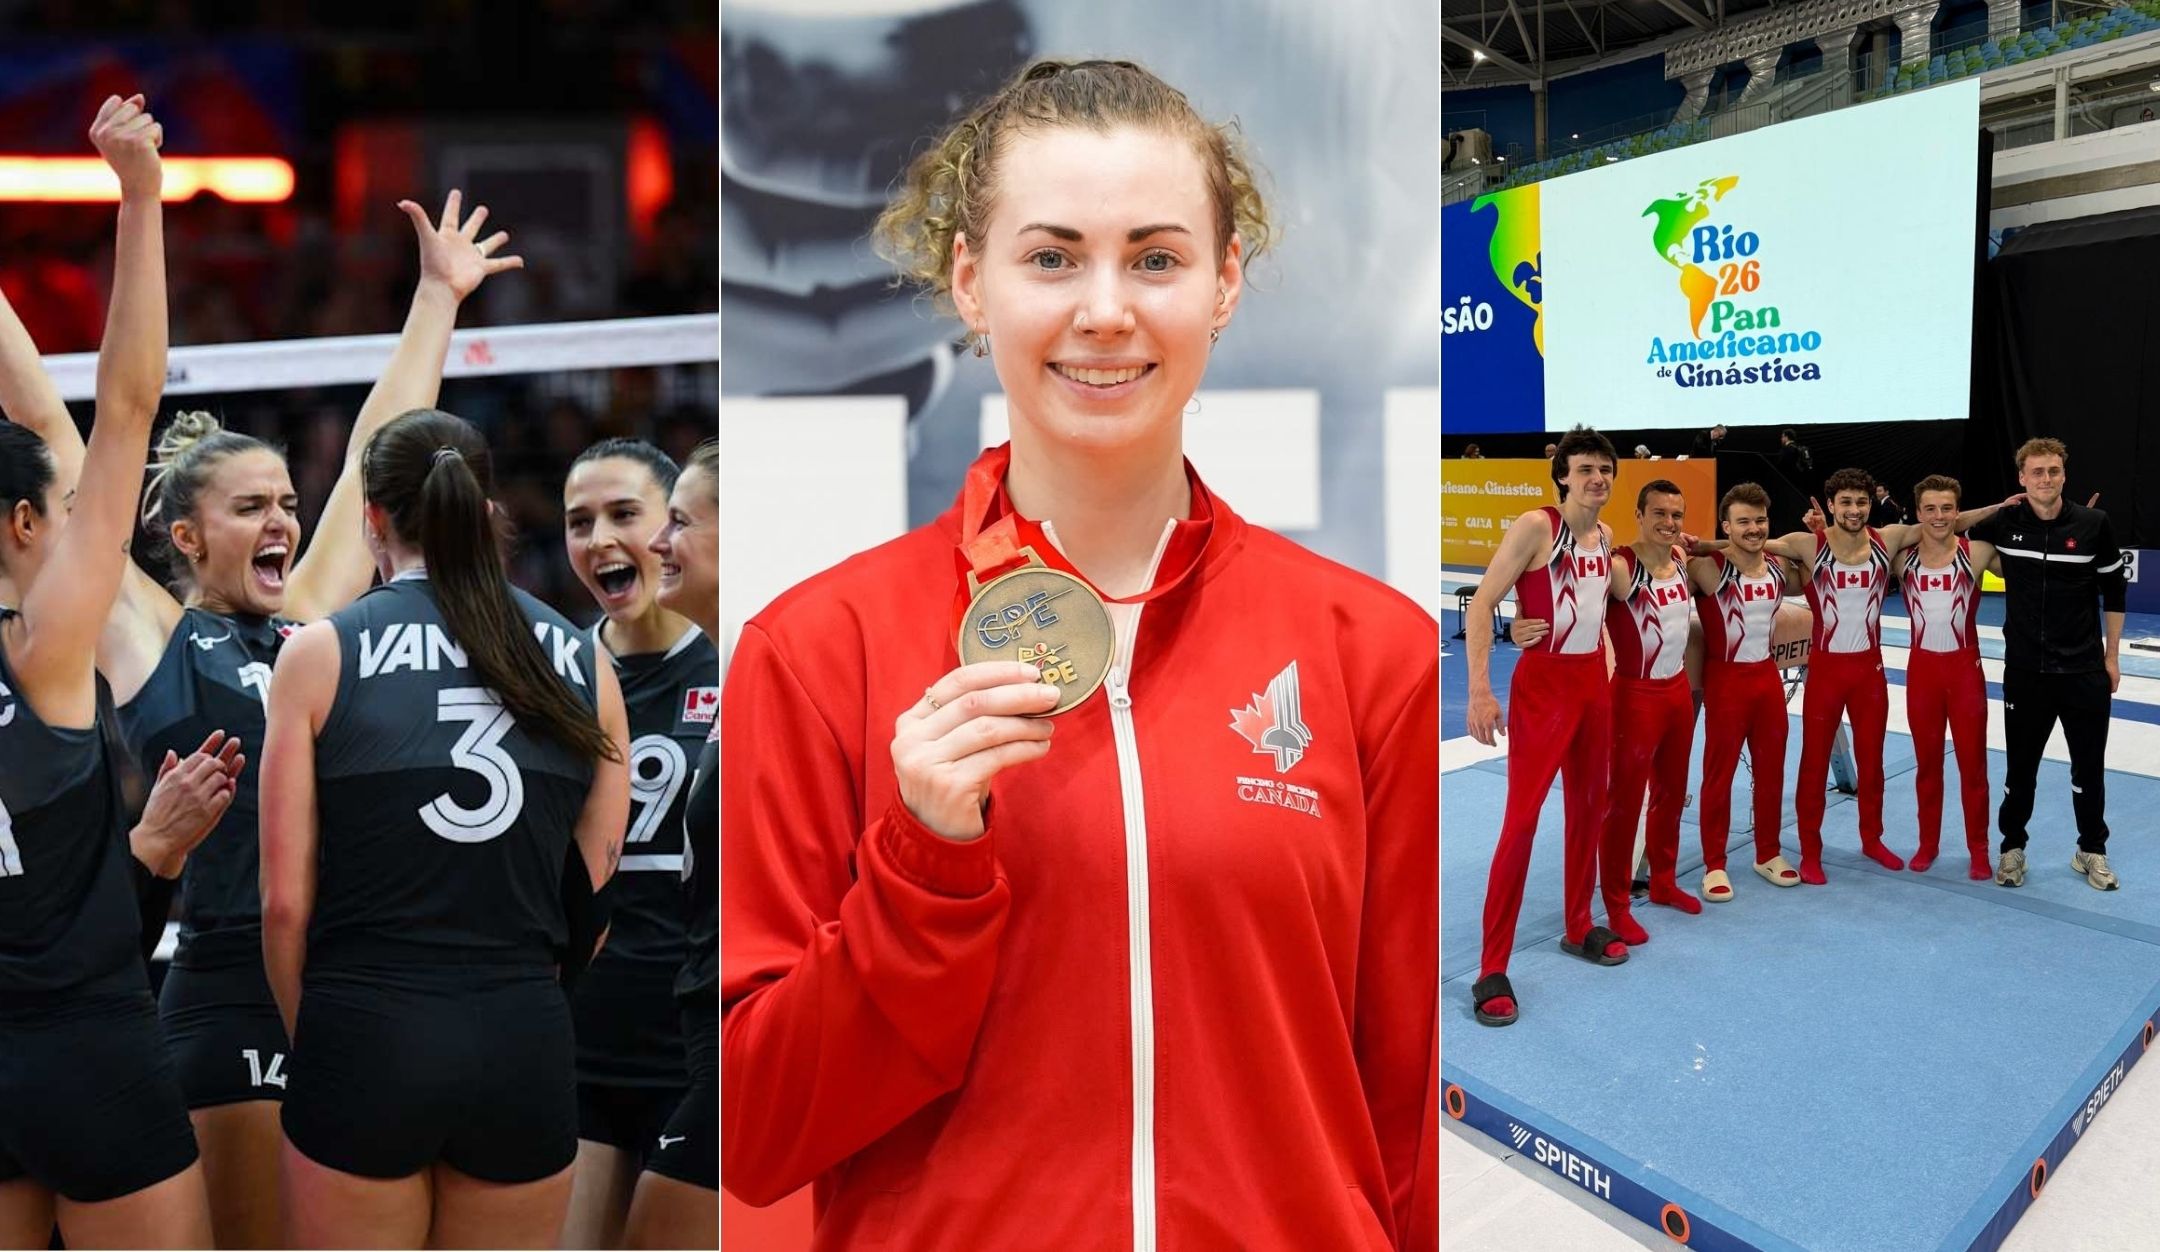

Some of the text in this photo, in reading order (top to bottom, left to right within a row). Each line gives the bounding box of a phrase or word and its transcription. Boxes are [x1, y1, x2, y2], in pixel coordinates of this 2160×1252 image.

[1692, 224, 1760, 264] Rio
[1719, 260, 1760, 296] 26
[1441, 295, 1494, 335] SÃO
[1711, 300, 1781, 333] Pan
[1646, 330, 1822, 364] Americano
[1656, 357, 1822, 388] de Ginástica
[1465, 516, 1493, 529] CAIXA
[977, 590, 1060, 649] CPE
[418, 686, 525, 843] 3
[1237, 785, 1322, 818] CANADA
[242, 1049, 289, 1090] 14
[2086, 1060, 2124, 1124] SPIETH
[1534, 1136, 1611, 1200] SPIETH
